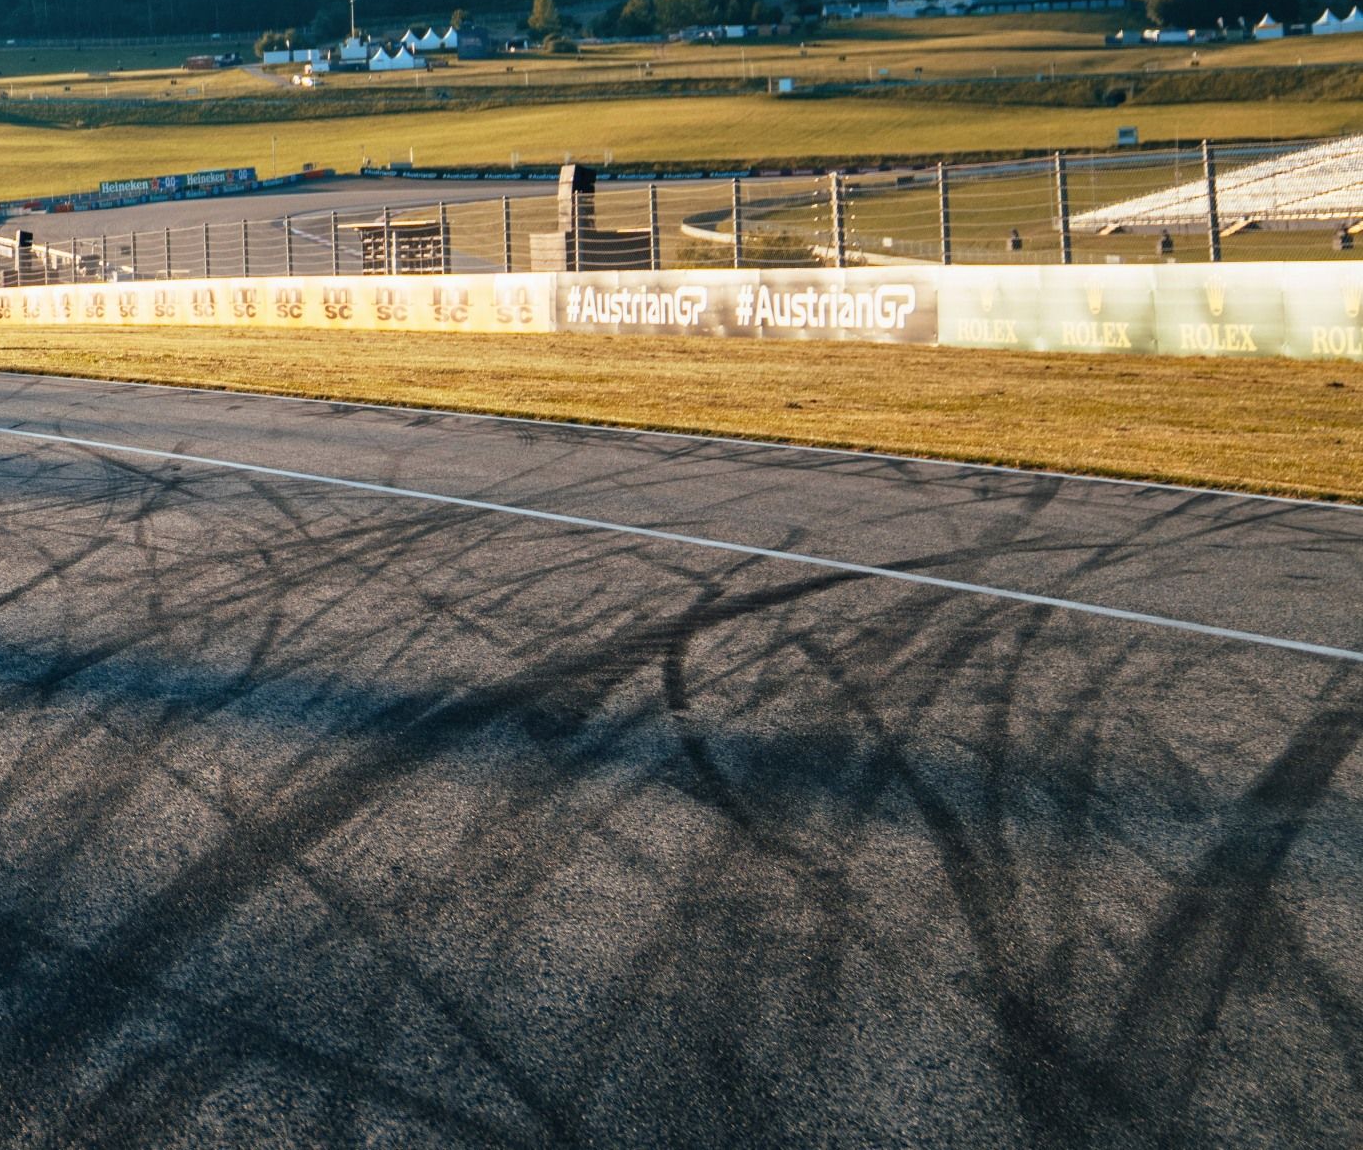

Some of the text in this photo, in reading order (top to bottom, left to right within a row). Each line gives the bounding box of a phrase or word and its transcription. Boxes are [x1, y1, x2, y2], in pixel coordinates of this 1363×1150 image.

[101, 180, 148, 194] Heineken
[187, 172, 225, 185] Heineken
[566, 285, 708, 327] #AustrianGP
[735, 284, 916, 329] #AustrianGP
[956, 319, 1019, 343] ROLEX
[1062, 321, 1132, 348] ROLEX
[1179, 323, 1258, 351] ROLEX
[1311, 326, 1363, 354] ROL
